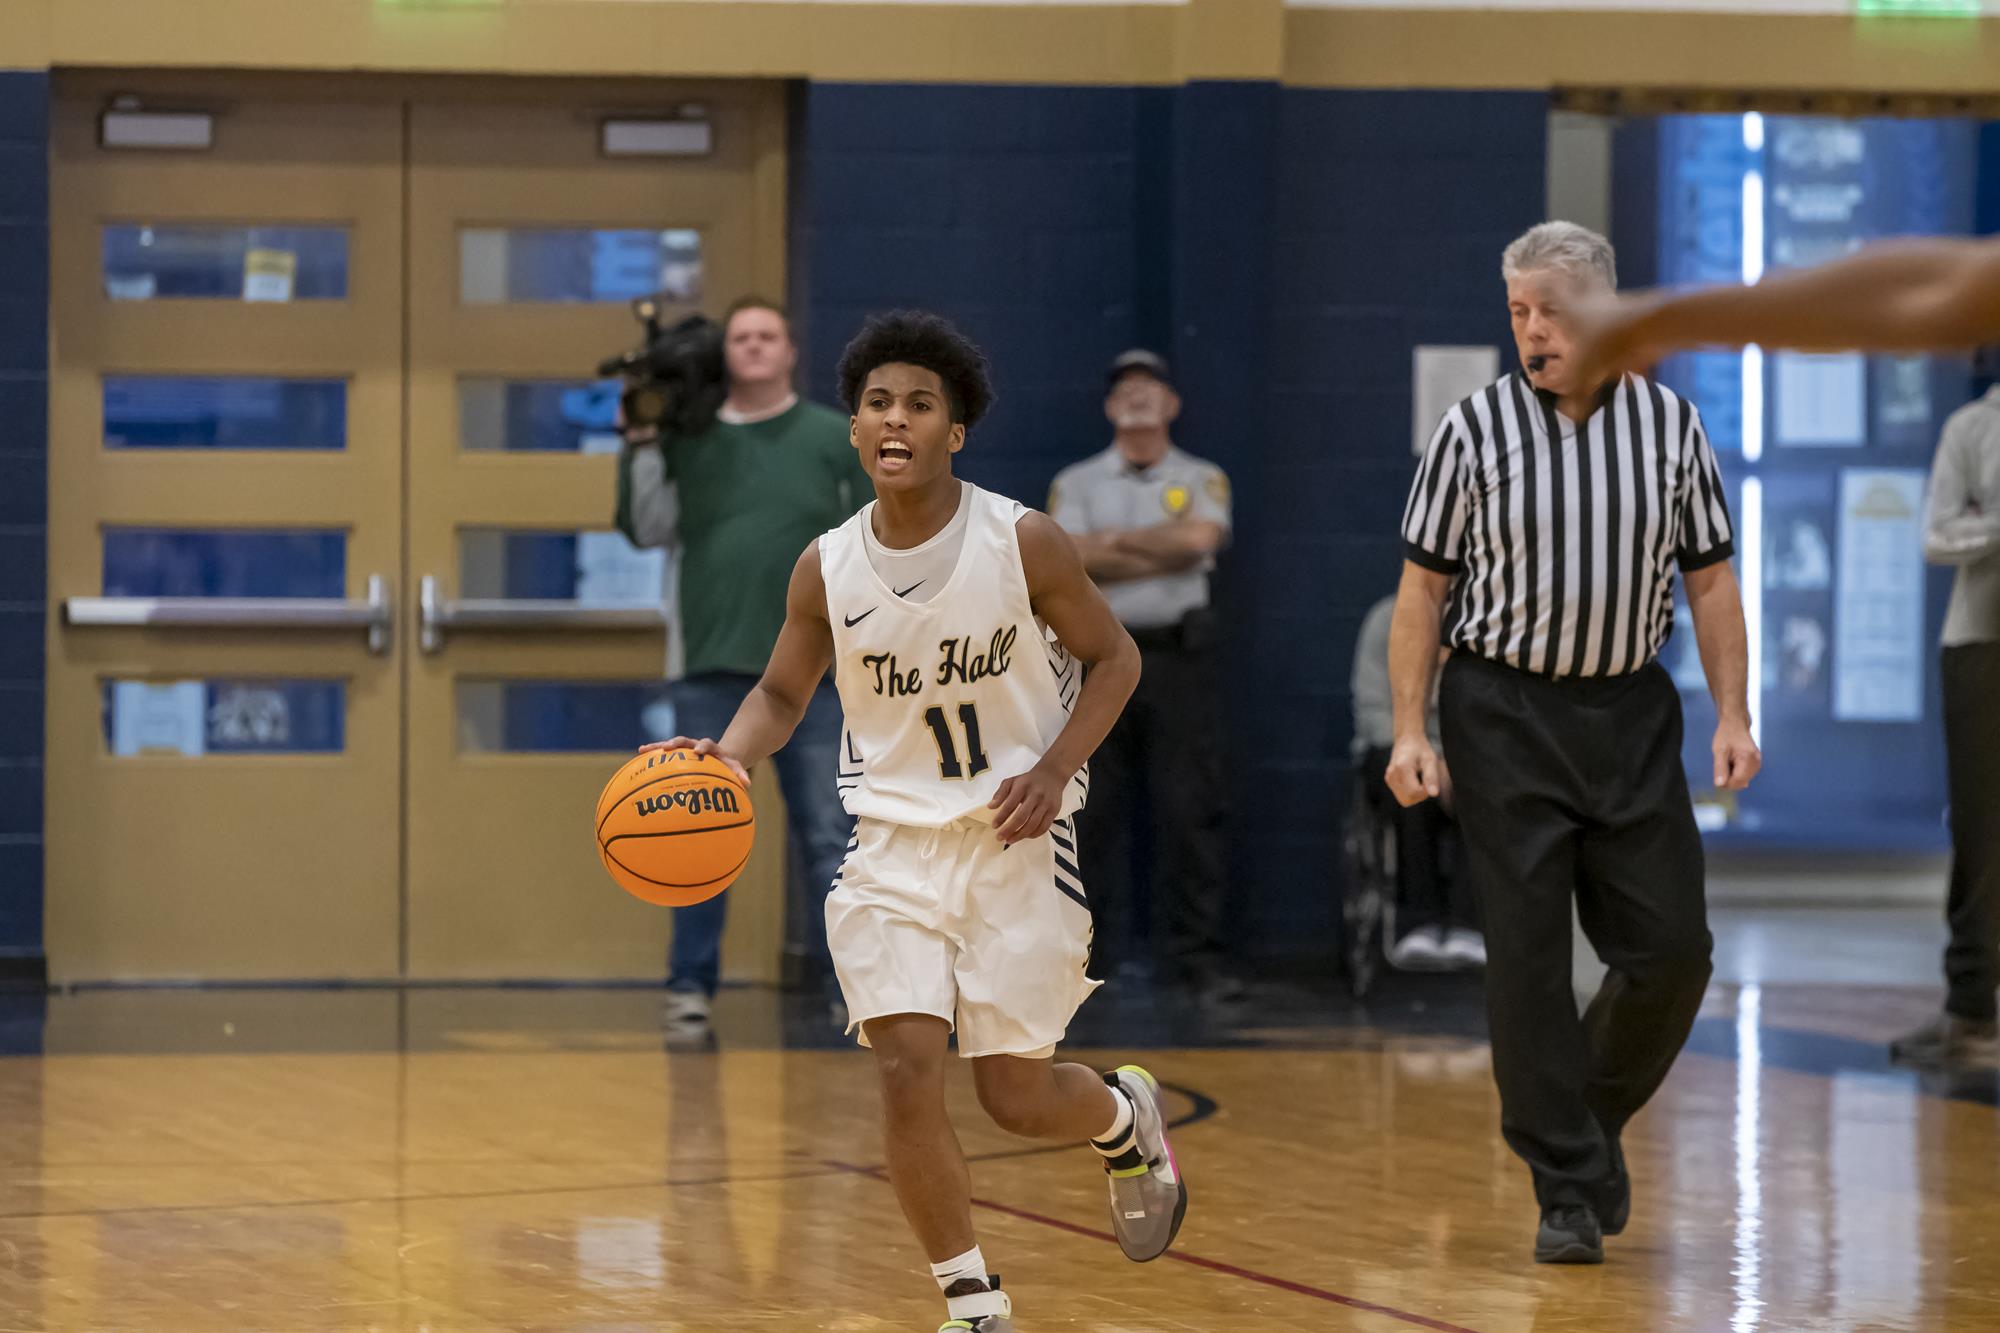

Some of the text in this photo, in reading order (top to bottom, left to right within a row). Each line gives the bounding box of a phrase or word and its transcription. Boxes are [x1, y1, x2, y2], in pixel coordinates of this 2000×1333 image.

[862, 624, 1017, 697] The Hall
[922, 700, 992, 782] 11
[635, 787, 739, 817] Wilson
